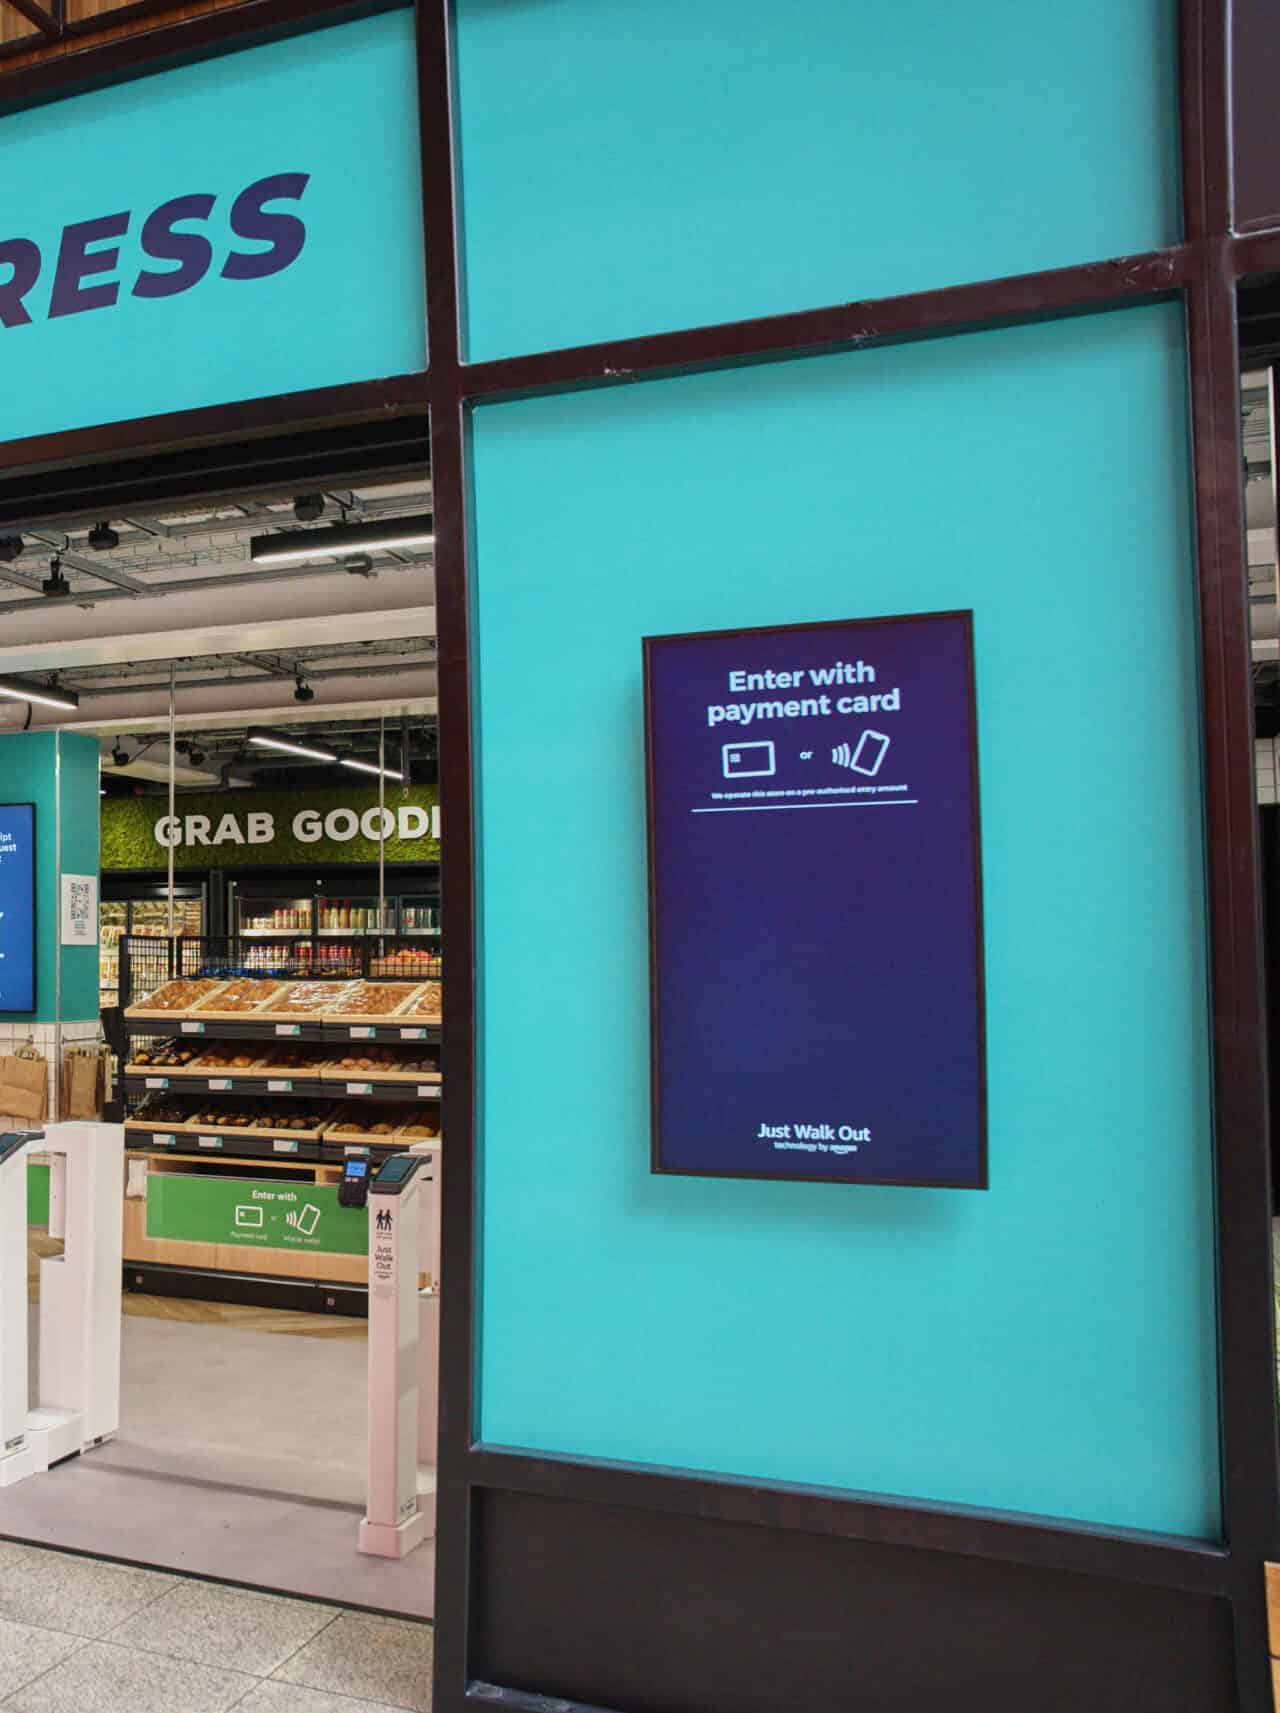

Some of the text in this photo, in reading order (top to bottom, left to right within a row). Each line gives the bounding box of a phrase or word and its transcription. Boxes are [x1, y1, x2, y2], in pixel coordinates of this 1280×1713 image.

[728, 660, 876, 692] Enter with
[707, 688, 901, 727] payment card
[799, 750, 813, 761] or
[154, 812, 275, 847] GRAB
[757, 1123, 871, 1142] Just Walk Out
[251, 1190, 297, 1201] Enter with
